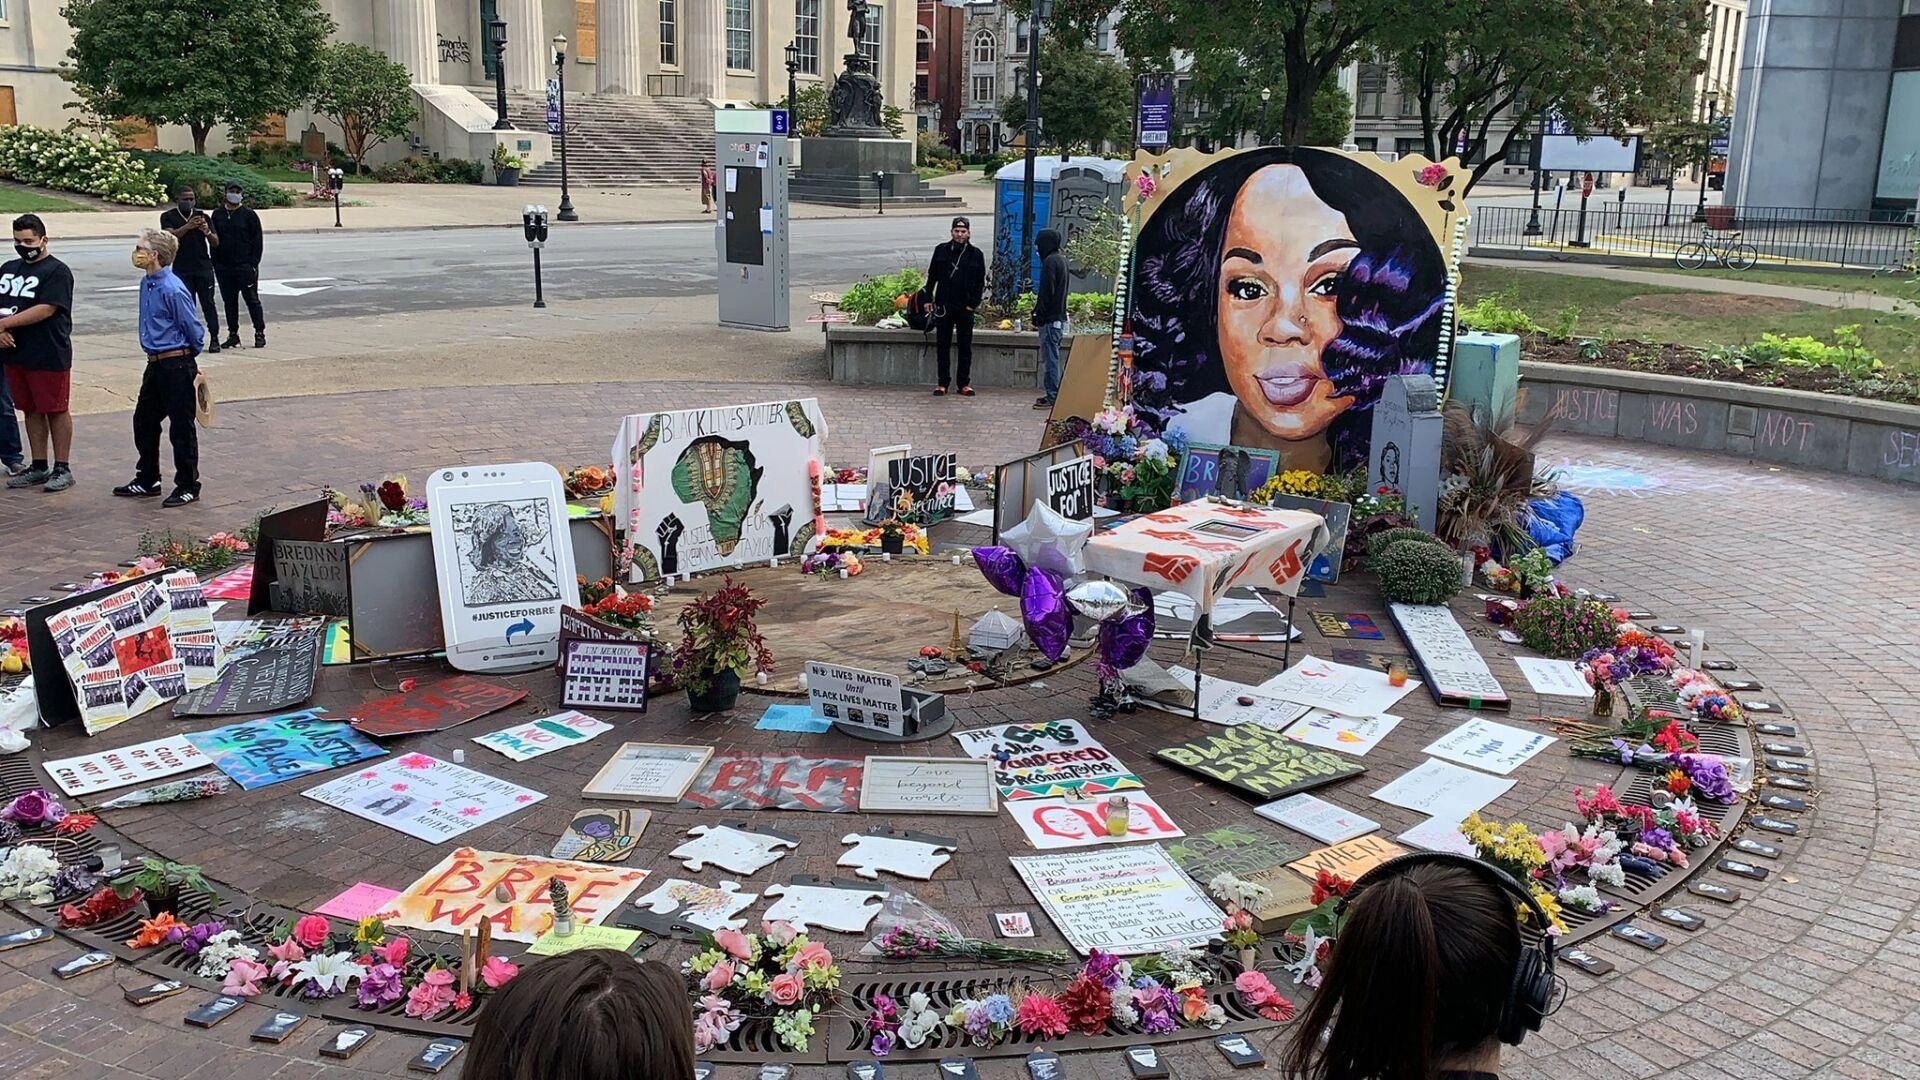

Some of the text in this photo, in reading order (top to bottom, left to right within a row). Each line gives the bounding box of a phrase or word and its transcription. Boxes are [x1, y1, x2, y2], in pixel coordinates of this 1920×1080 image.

[661, 411, 705, 444] BLACK
[747, 402, 784, 425] MATTER
[1650, 399, 1698, 435] WAS
[1760, 411, 1815, 452] NOT
[889, 452, 957, 490] JUSTICE
[1049, 461, 1091, 497] JUSTICE
[746, 512, 770, 534] FOR
[170, 576, 199, 587] WANTED
[280, 562, 341, 581] TAYLOR
[102, 592, 131, 610] WANTED
[472, 606, 556, 623] #JUSTICEFORBRE
[80, 628, 108, 651] WANTED
[586, 646, 633, 656] IN MEMORY
[86, 669, 117, 683] WANTED
[148, 663, 180, 677] WANTED
[831, 669, 853, 681] LIVES
[856, 672, 893, 688] MATTER
[247, 658, 277, 703] THEY ARE
[566, 675, 645, 704] TAYLOR
[845, 683, 864, 695] Until
[812, 688, 898, 713] BLACK LIVES MATTER
[561, 714, 598, 729] NO
[518, 728, 556, 743] NO
[959, 725, 1077, 745] THE COPS
[1157, 720, 1290, 766] BLACK
[131, 749, 162, 771] OF MY
[154, 746, 184, 768] COLOR
[178, 744, 200, 758] THE
[226, 726, 303, 775] NO PEACE
[101, 753, 138, 782] SKIN IS
[903, 765, 953, 777] Love
[1198, 739, 1307, 783] LIVES
[56, 767, 85, 790] CRIME
[78, 761, 103, 785] NOT A
[342, 774, 384, 791] REST
[432, 761, 453, 774] SAY
[455, 767, 482, 785] HER
[708, 759, 865, 793] BLM
[1242, 751, 1365, 794] MATTER
[897, 778, 963, 791] beyond
[899, 792, 964, 806] words
[413, 813, 430, 825] NO
[427, 807, 443, 817] NO
[1047, 861, 1064, 870] my
[1105, 854, 1131, 862] were
[1300, 838, 1386, 872] WHEN
[1034, 867, 1067, 878] SHOT
[1089, 864, 1114, 872] their
[1118, 859, 1156, 868] homes
[418, 860, 620, 915] BREE
[1045, 877, 1093, 887] Breonna
[1048, 888, 1068, 896] OR
[1060, 893, 1099, 903] George
[1072, 911, 1186, 932] This MAMA would
[1079, 931, 1113, 946] NOT
[1140, 917, 1222, 939] SILENCED
